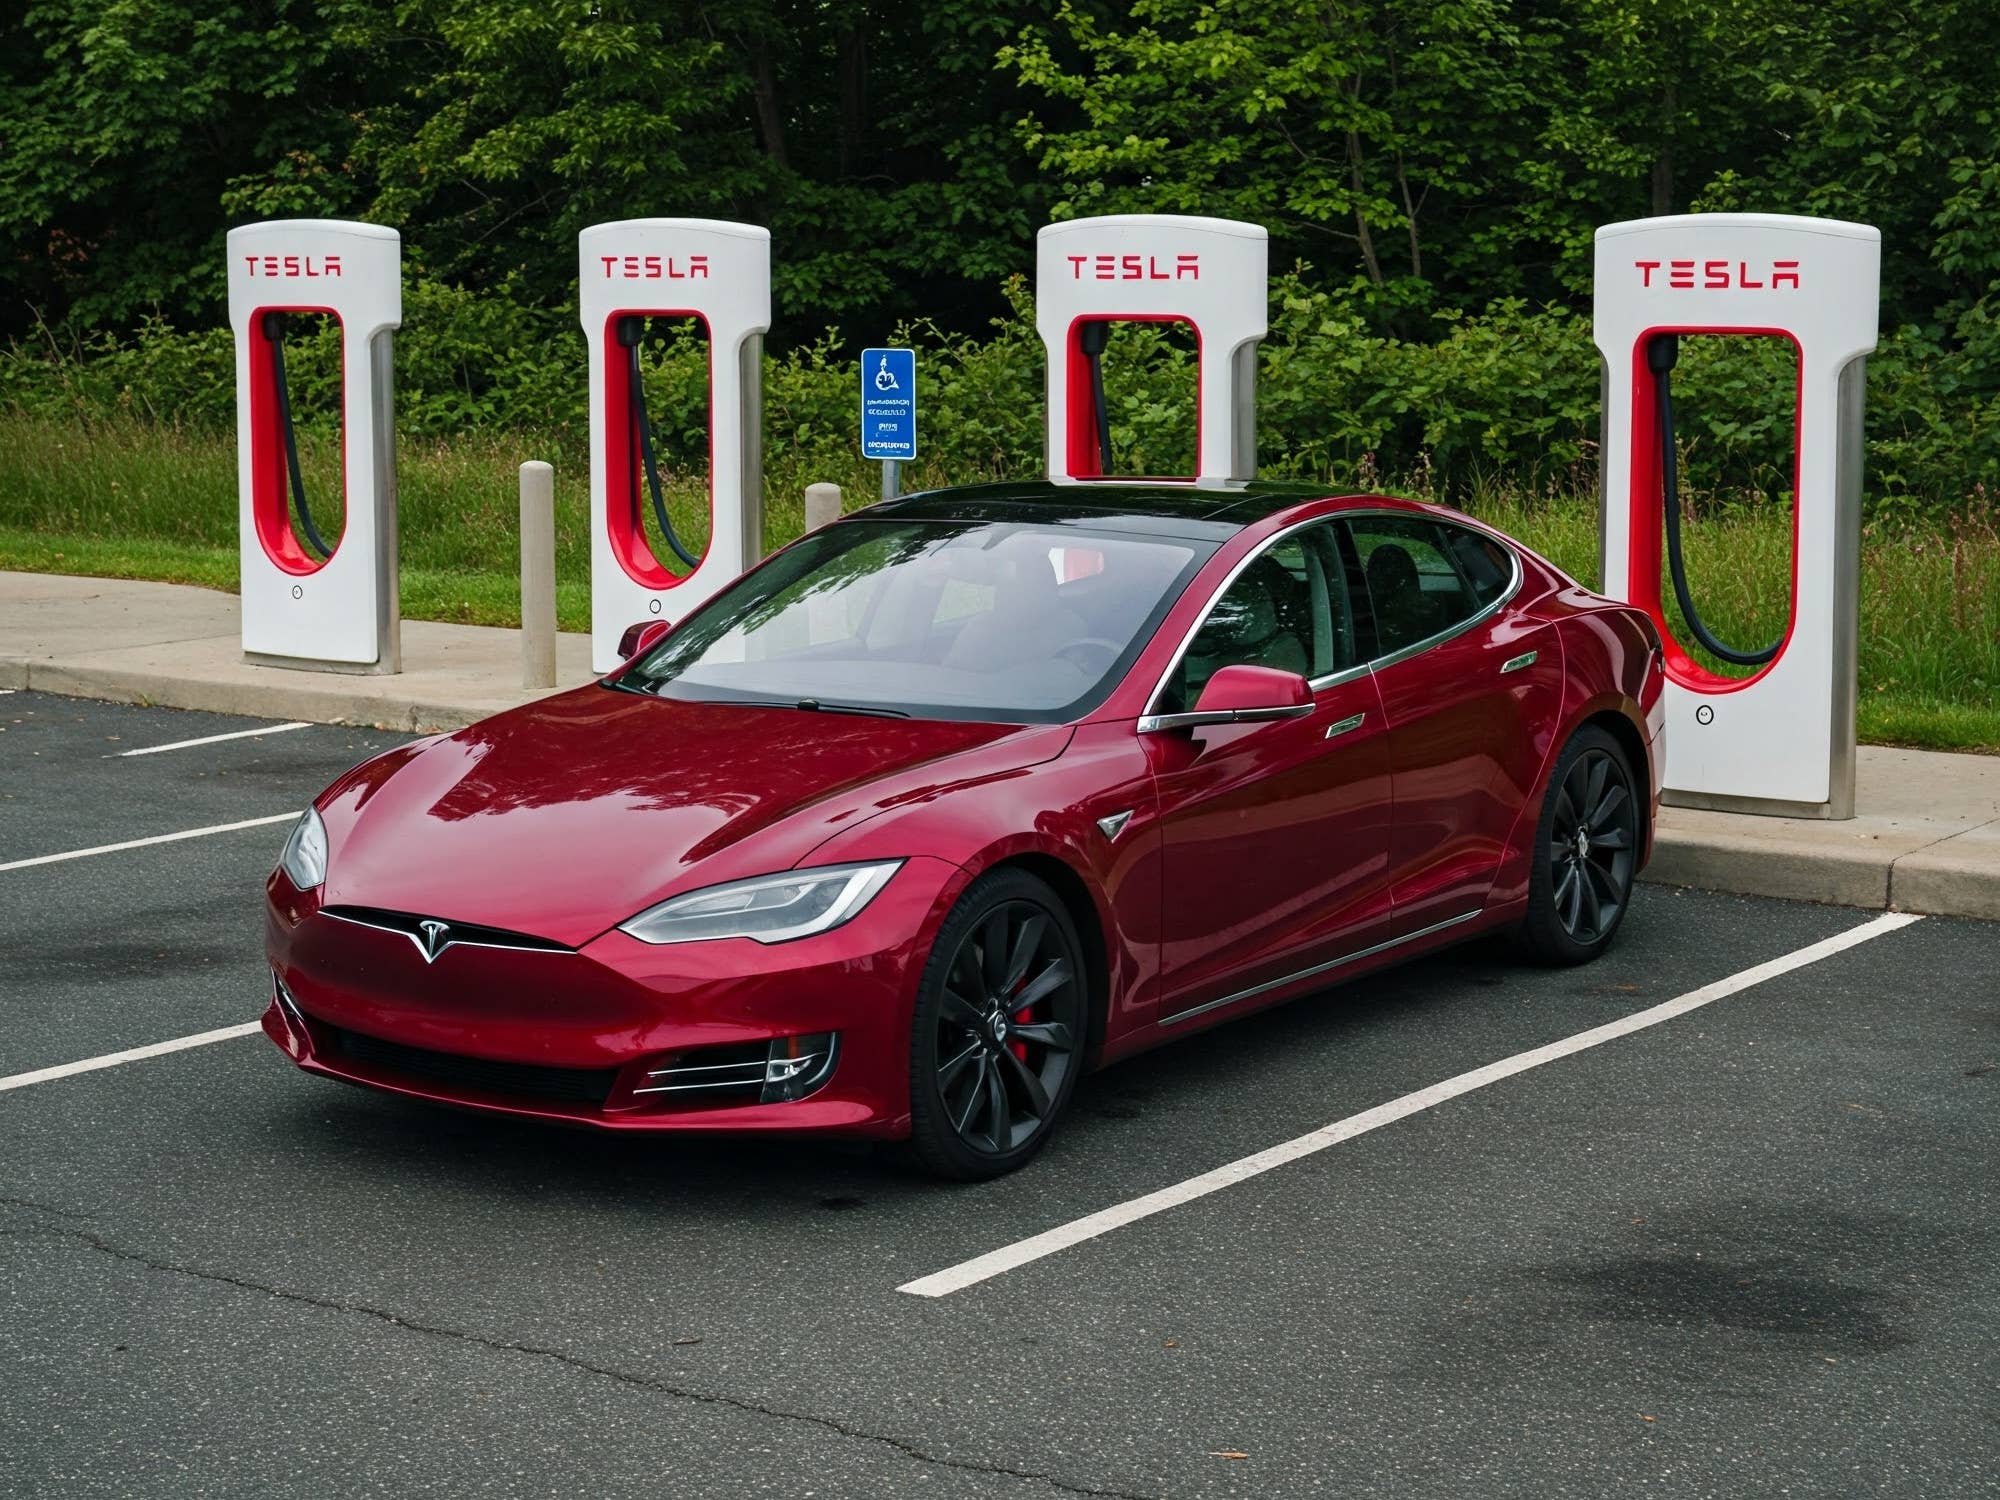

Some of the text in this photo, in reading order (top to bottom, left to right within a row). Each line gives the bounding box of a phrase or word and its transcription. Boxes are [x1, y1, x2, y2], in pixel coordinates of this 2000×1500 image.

[246, 257, 341, 276] TESLA
[601, 257, 708, 278] TESLA
[1068, 256, 1200, 279] TESLA
[1636, 261, 1799, 288] TESLA
